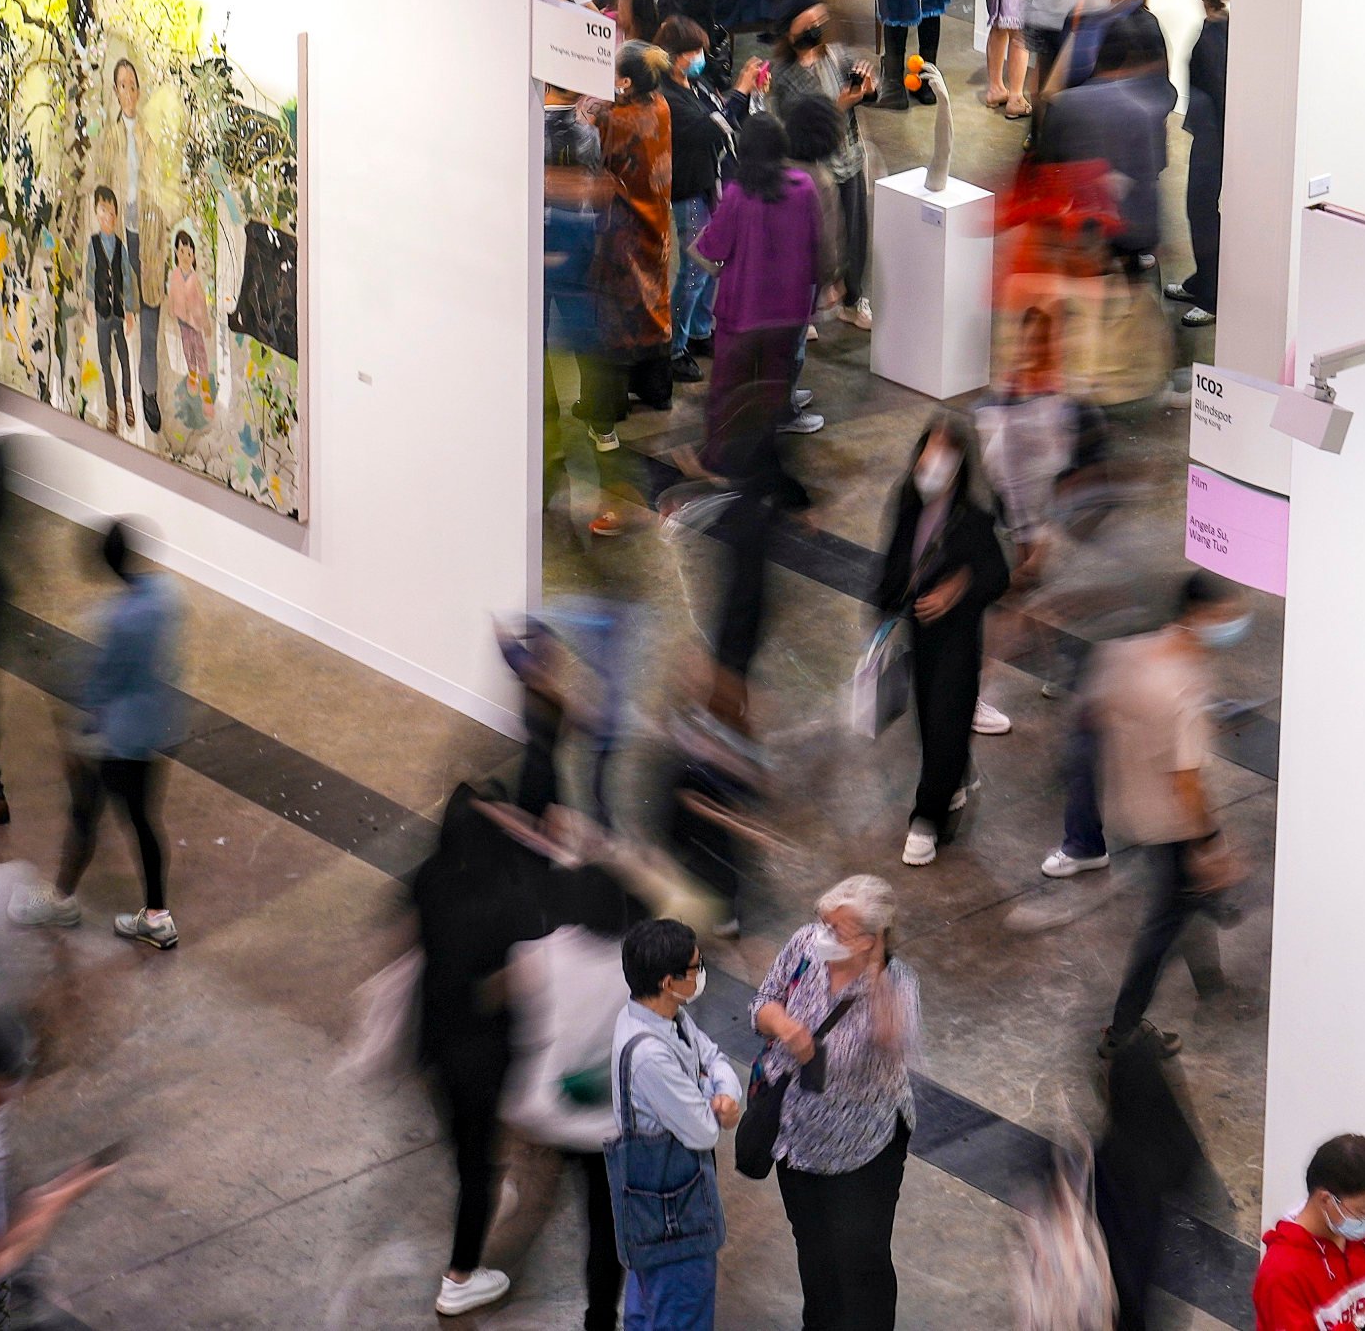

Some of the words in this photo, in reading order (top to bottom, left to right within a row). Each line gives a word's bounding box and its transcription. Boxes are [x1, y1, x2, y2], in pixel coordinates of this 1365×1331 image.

[586, 22, 612, 40] 1C10
[597, 45, 611, 58] Ota
[1196, 373, 1223, 399] 1C02
[1195, 398, 1232, 425] Blindspot
[1191, 474, 1208, 491] Film
[1189, 515, 1215, 536] Angela
[1217, 527, 1229, 544] Su,
[1189, 527, 1211, 550] Wang
[1212, 539, 1228, 555] Tuo
